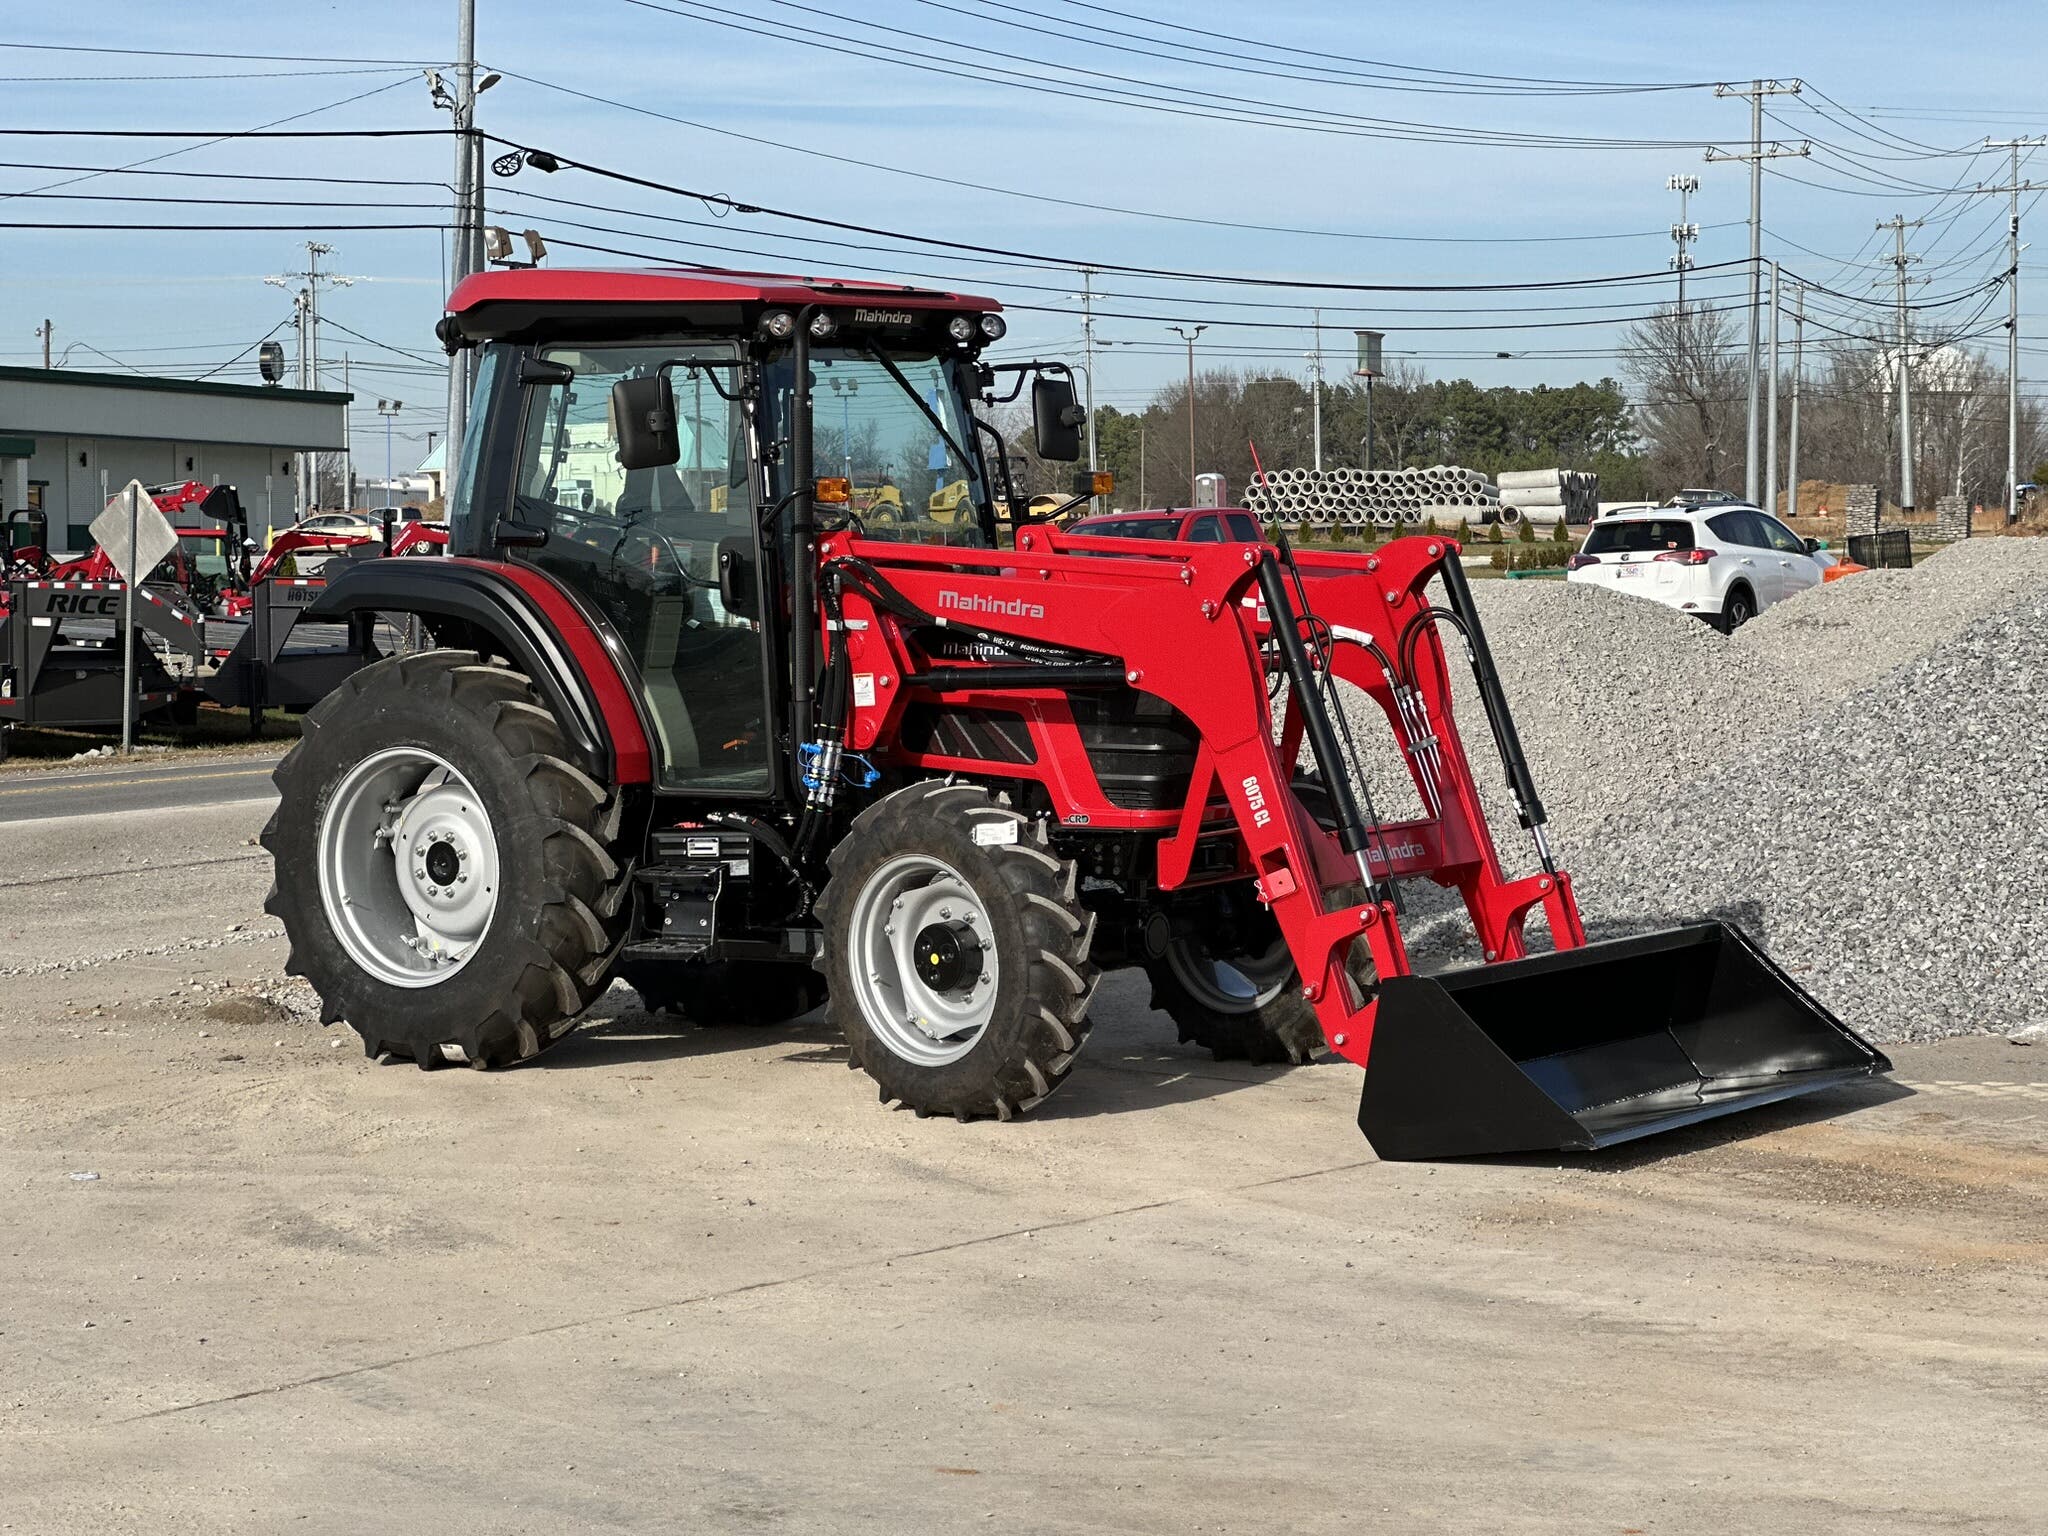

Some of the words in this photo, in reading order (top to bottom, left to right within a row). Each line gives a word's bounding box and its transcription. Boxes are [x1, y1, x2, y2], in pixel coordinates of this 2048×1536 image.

[855, 308, 912, 324] Mahindra
[46, 594, 120, 615] RICE
[938, 590, 1045, 618] Mahindra
[1242, 775, 1265, 811] 6075
[1253, 809, 1271, 829] CL
